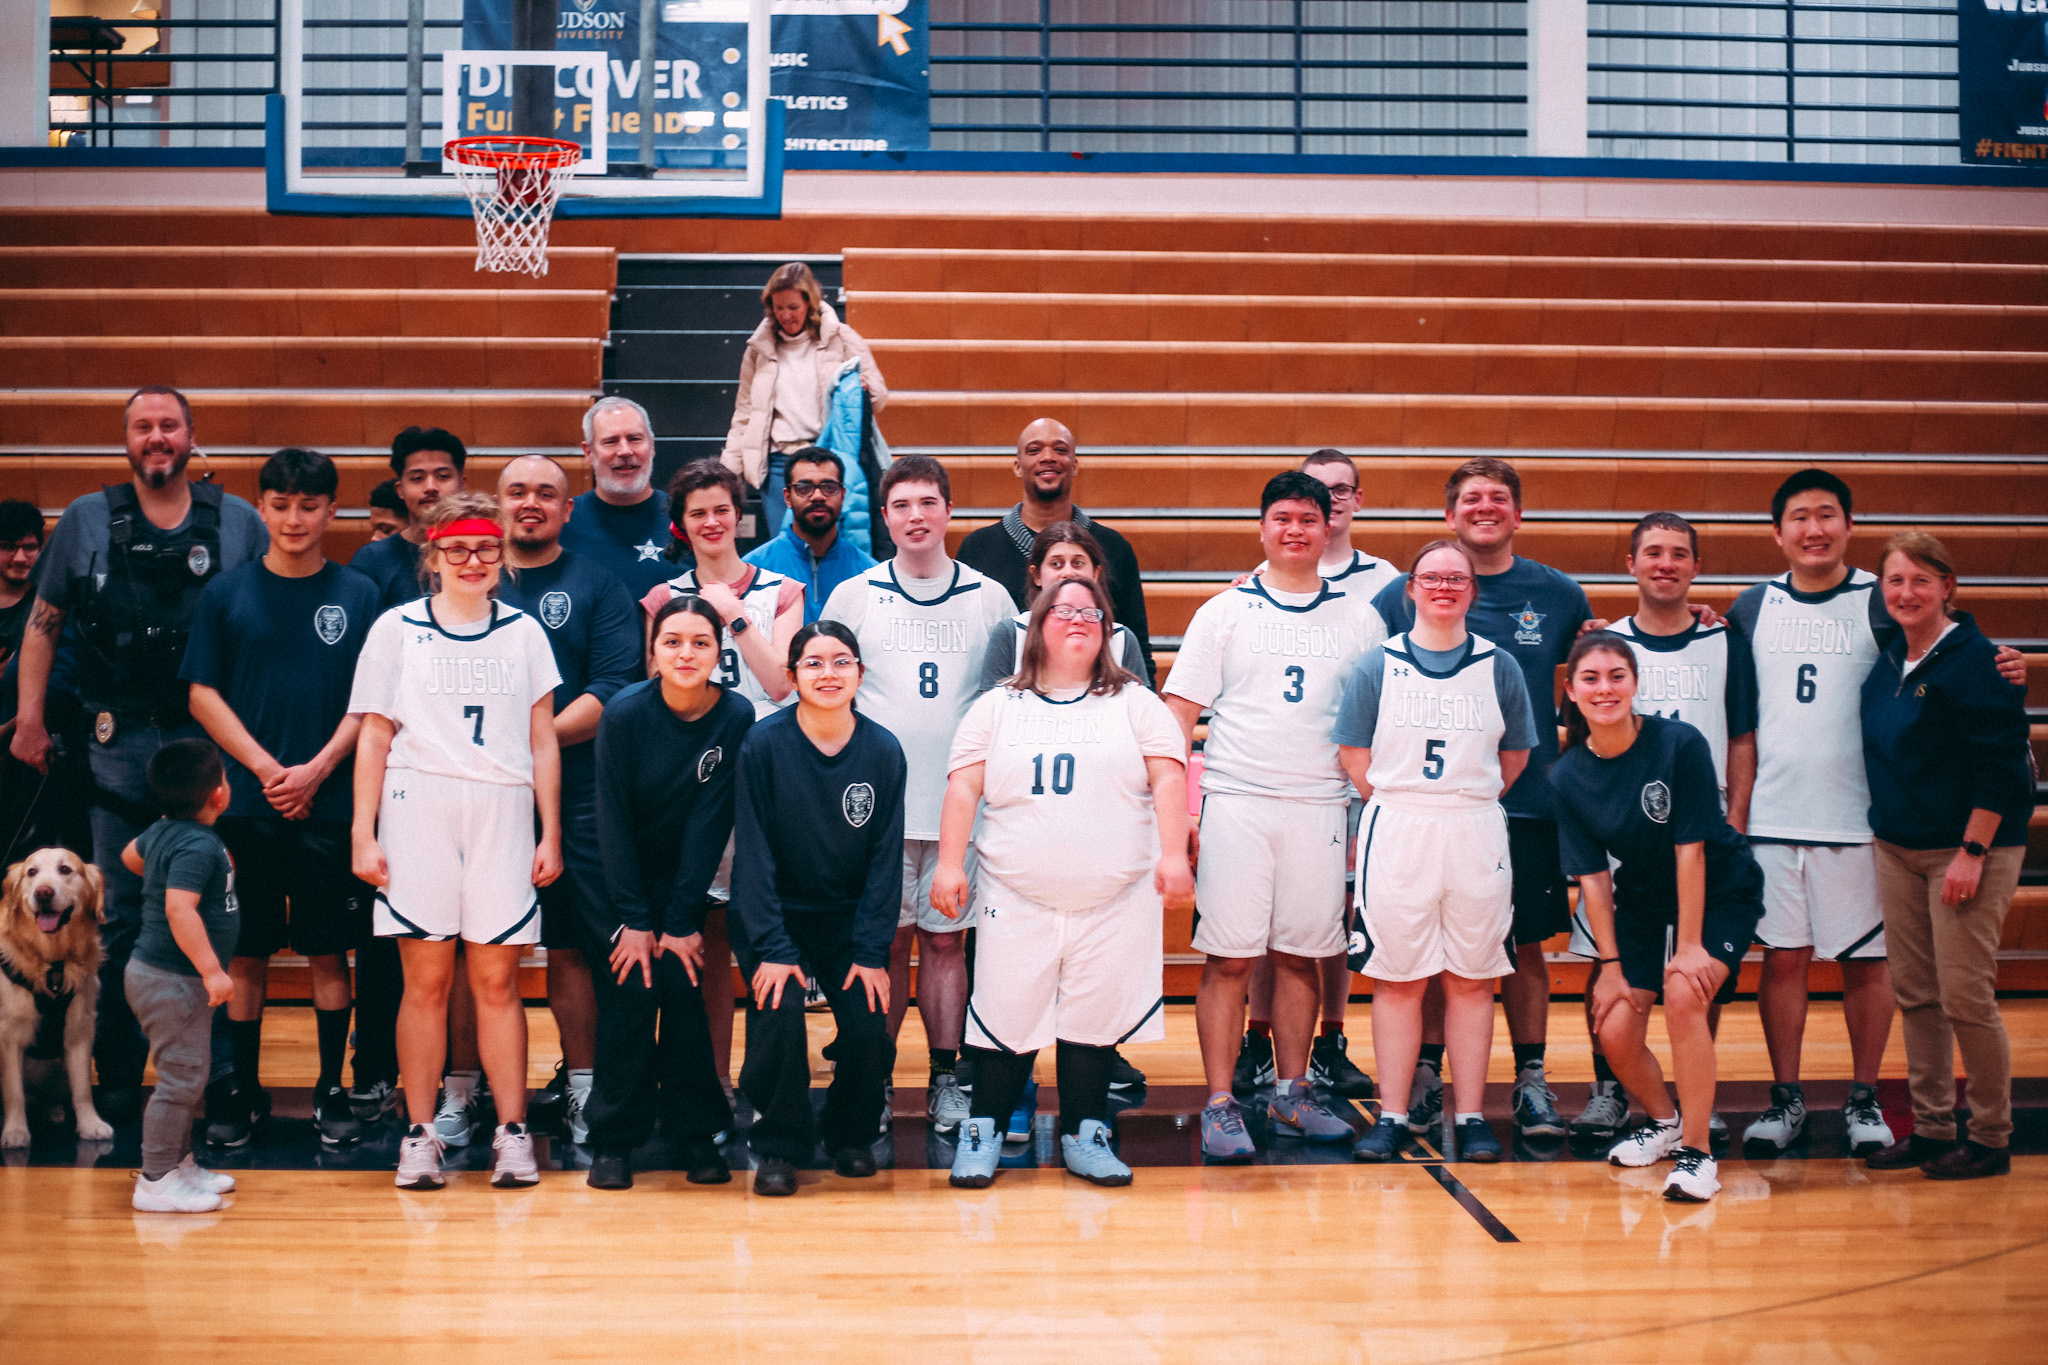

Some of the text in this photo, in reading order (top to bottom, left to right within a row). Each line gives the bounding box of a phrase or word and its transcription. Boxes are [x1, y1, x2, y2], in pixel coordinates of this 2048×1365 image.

[556, 11, 626, 29] UDSON
[468, 59, 702, 99] DICOVER
[769, 52, 808, 67] USIC
[882, 617, 968, 654] JUDSON
[1250, 622, 1341, 660] JUDSON
[1768, 617, 1855, 656] JUDSON
[424, 656, 517, 697] JUDSON
[719, 648, 741, 688] 9
[919, 661, 939, 699] 8
[1283, 665, 1305, 703] 3
[1637, 664, 1709, 702] UDSON
[1796, 663, 1818, 703] 6
[463, 705, 485, 746] 7
[1393, 690, 1484, 732] JUDSON
[1031, 753, 1075, 795] 10
[1422, 739, 1446, 780] 5
